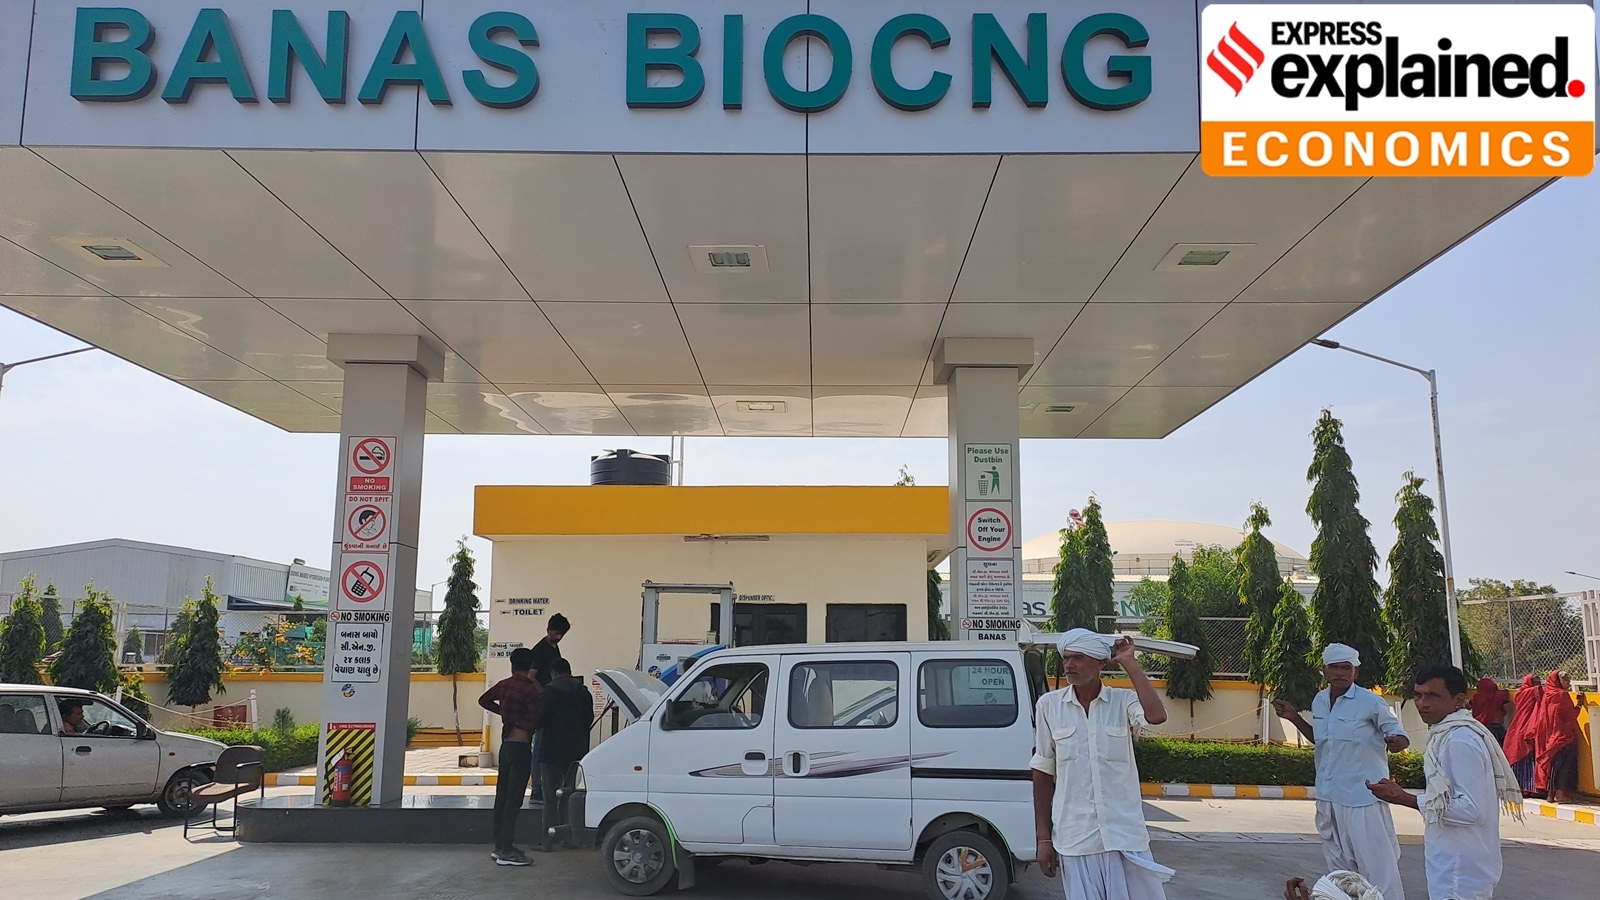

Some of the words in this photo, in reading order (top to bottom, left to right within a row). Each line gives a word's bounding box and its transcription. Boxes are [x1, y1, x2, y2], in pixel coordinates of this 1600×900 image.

[69, 6, 541, 109] BANAS
[625, 12, 1152, 112] BIOCNG
[967, 447, 992, 455] Please
[994, 447, 1009, 455] Use
[974, 456, 1003, 464] Dustbin
[977, 535, 1001, 544] Engine
[513, 608, 543, 616] TOILET
[340, 612, 352, 621] NO
[354, 612, 390, 622] SMOKING
[972, 619, 984, 629] NO
[985, 619, 1021, 629] SMOKING
[978, 633, 1007, 641] BANAS
[372, 664, 379, 674] છે
[984, 667, 1010, 675] HOUR
[981, 678, 1005, 686] OPEN
